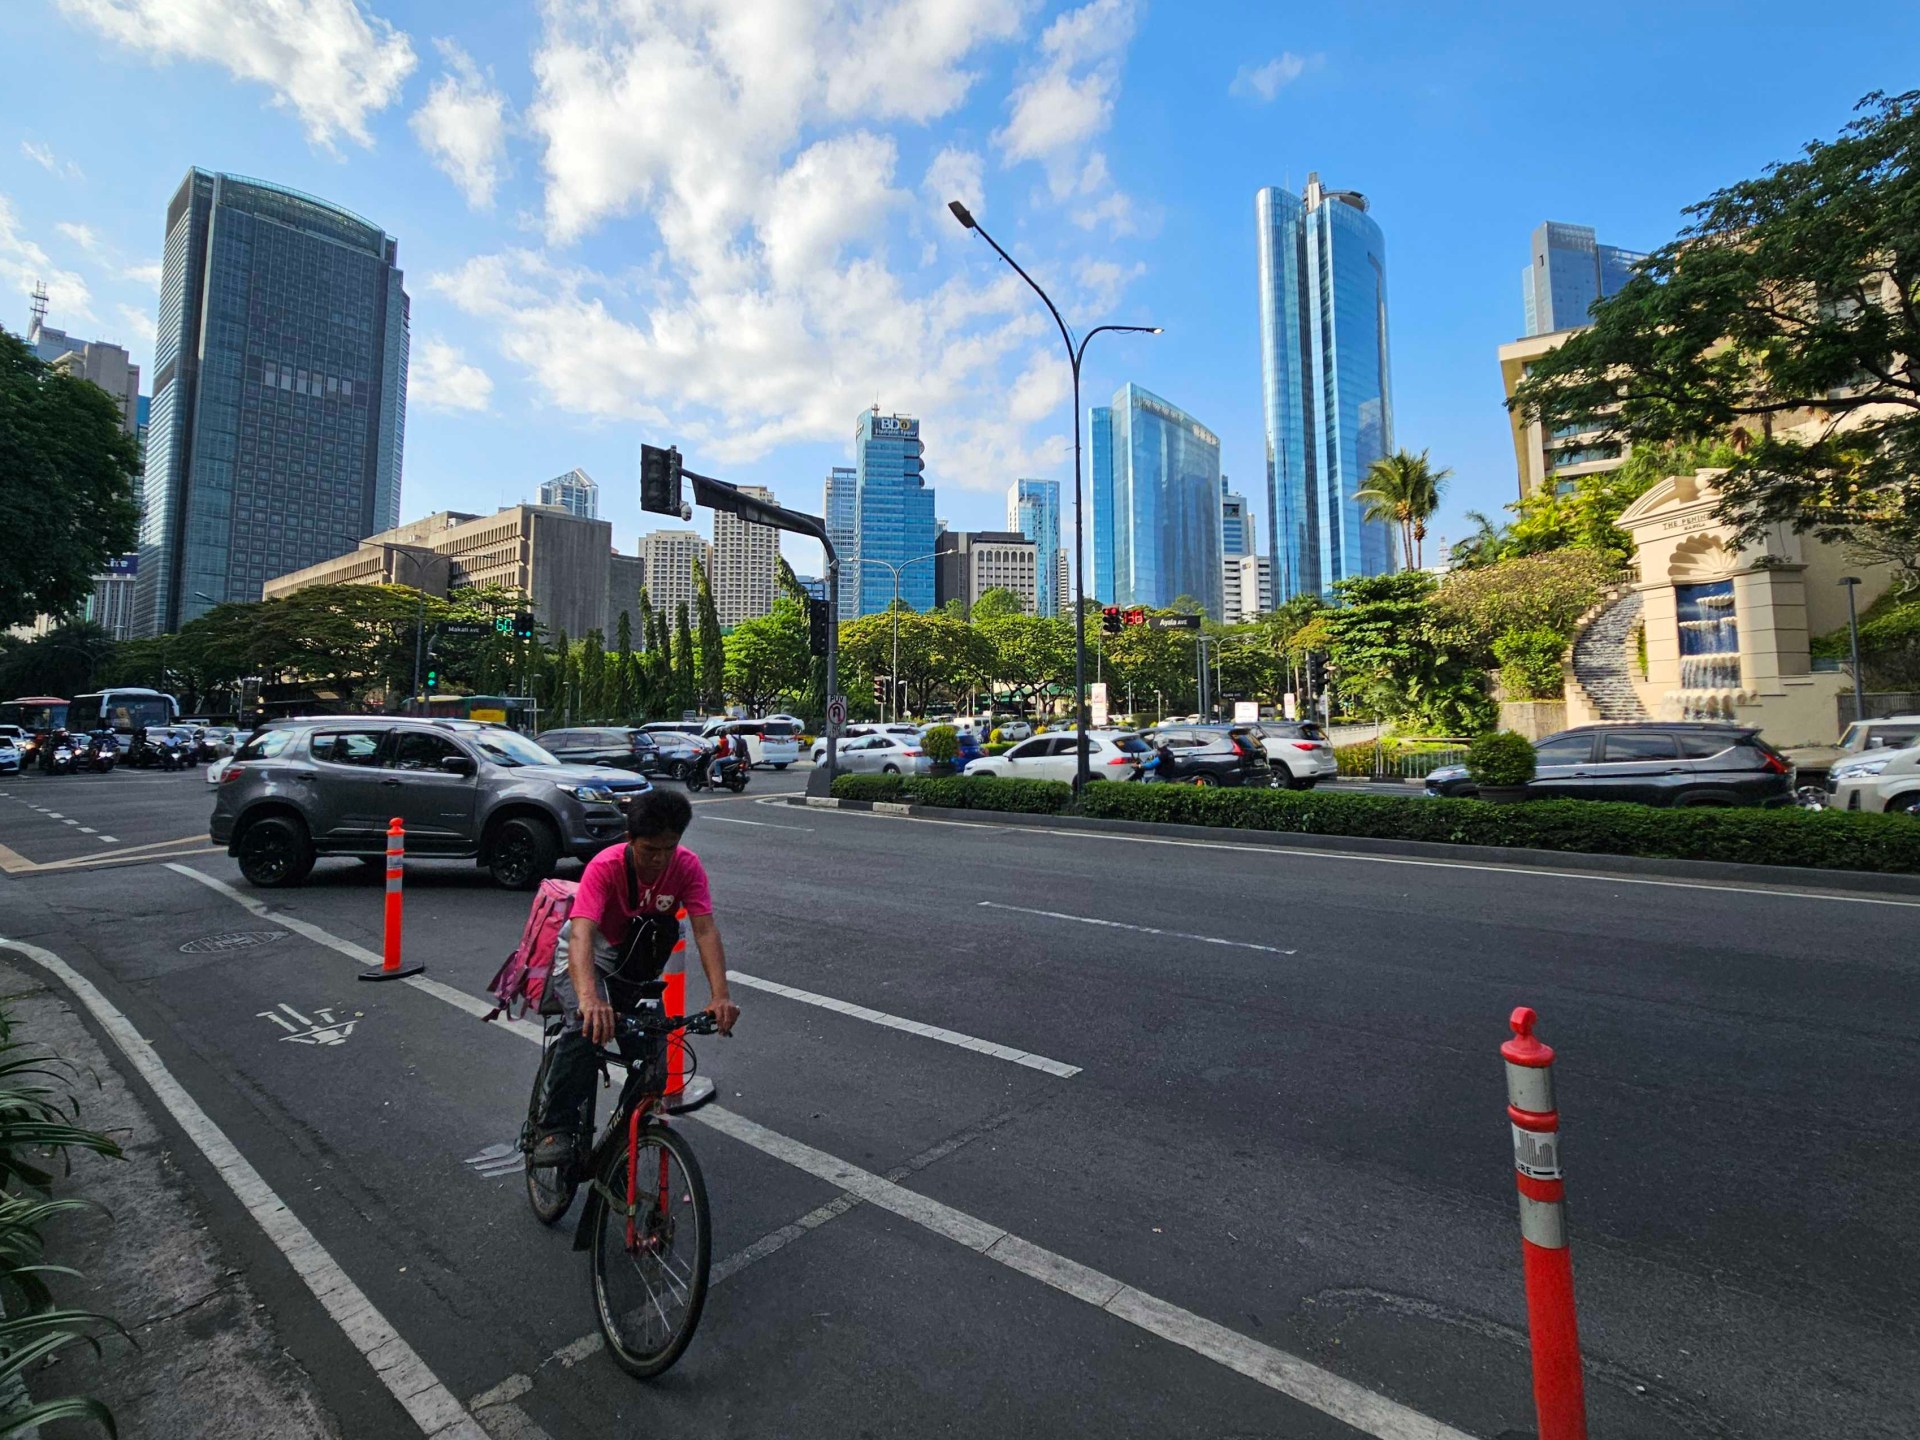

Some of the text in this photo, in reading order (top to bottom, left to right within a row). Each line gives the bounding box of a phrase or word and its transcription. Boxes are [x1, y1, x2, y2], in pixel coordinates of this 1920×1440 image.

[881, 418, 911, 430] BDO
[1662, 521, 1678, 530] THE
[496, 618, 512, 631] 60
[1160, 618, 1177, 627] Ayala
